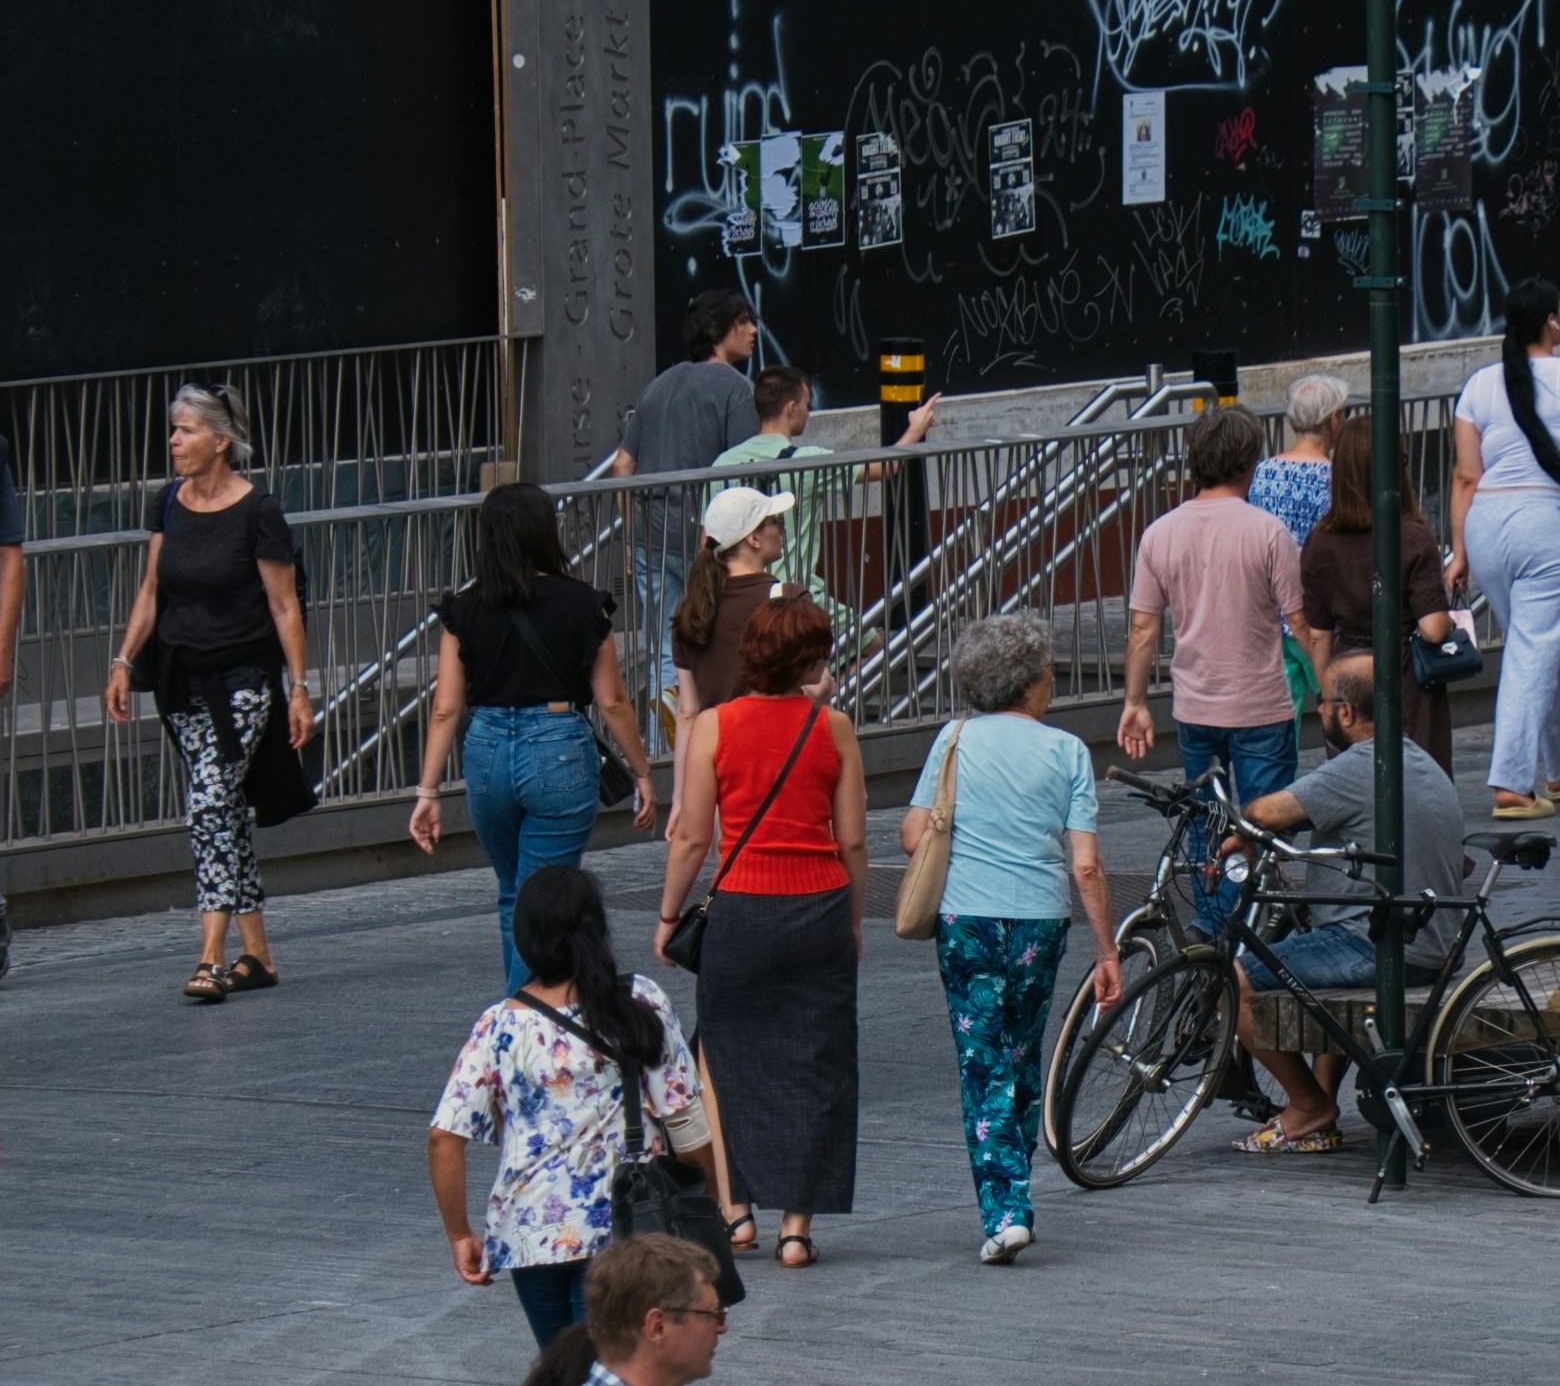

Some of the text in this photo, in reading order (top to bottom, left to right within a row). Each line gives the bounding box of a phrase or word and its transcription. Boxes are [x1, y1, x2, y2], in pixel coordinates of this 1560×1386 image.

[559, 13, 589, 327] Grand-Place
[603, 9, 632, 171] Markt
[608, 191, 635, 344] Grote
